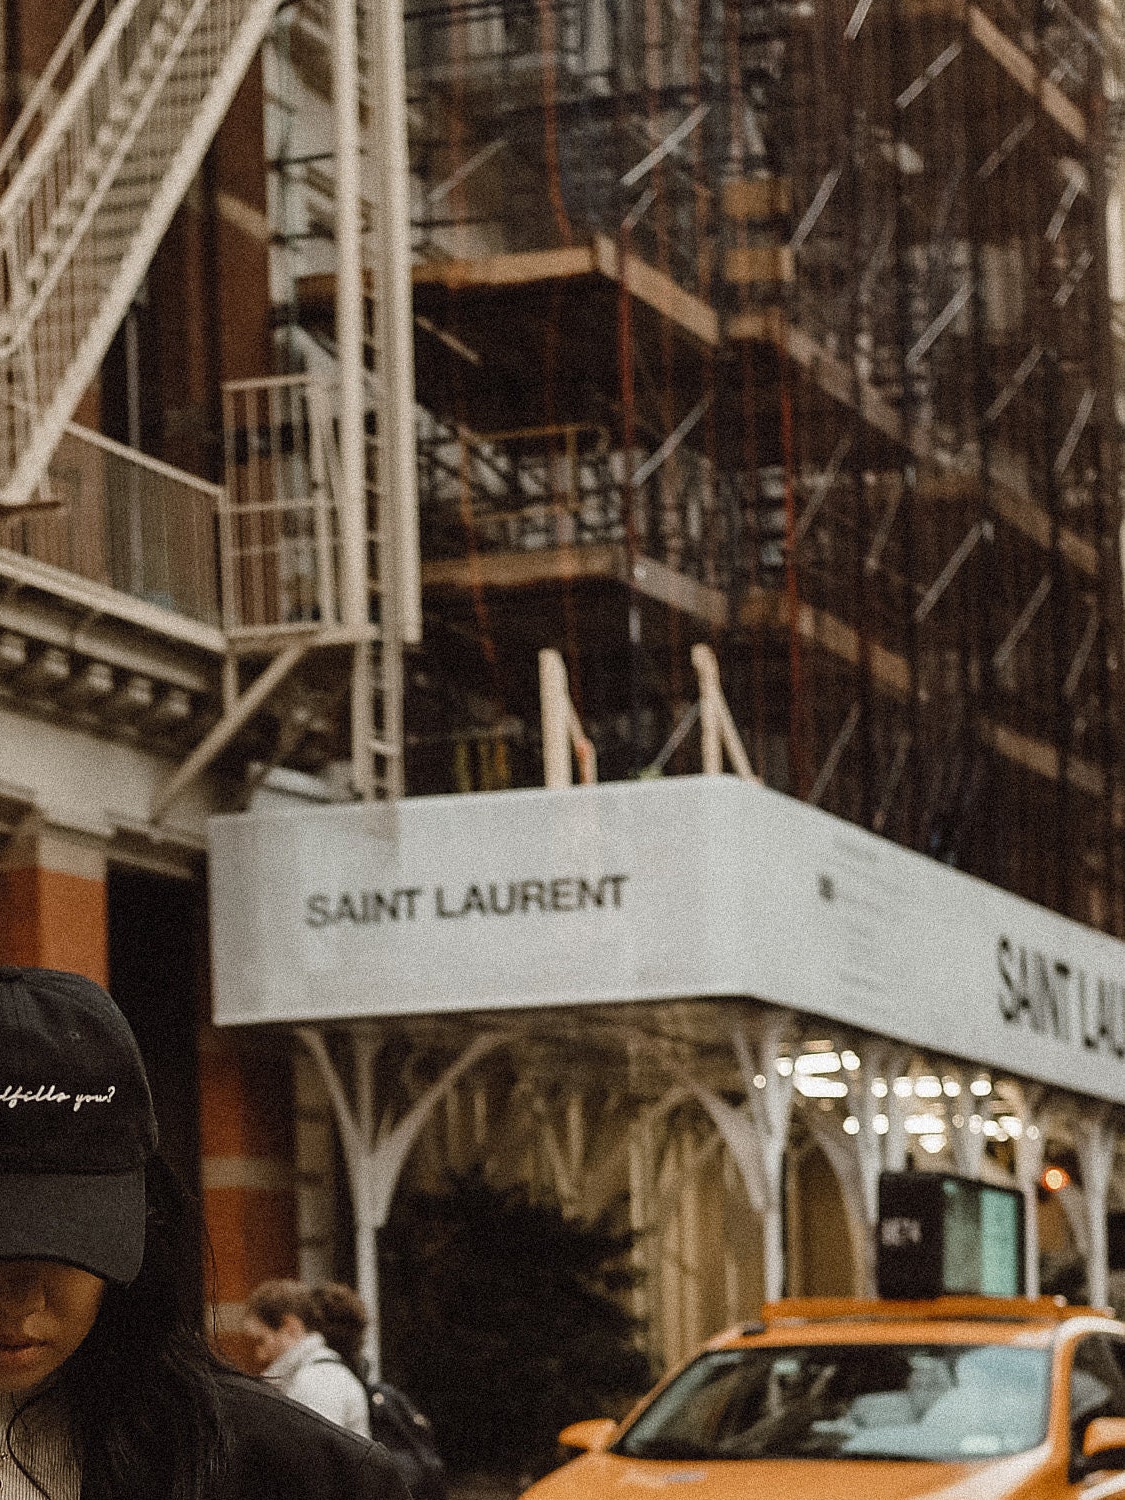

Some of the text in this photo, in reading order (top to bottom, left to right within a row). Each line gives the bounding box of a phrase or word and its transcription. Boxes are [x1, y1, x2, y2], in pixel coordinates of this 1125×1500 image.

[305, 873, 629, 929] SAINT LAURENT
[996, 934, 1072, 1045] SAINT
[73, 1085, 116, 1112] you?
